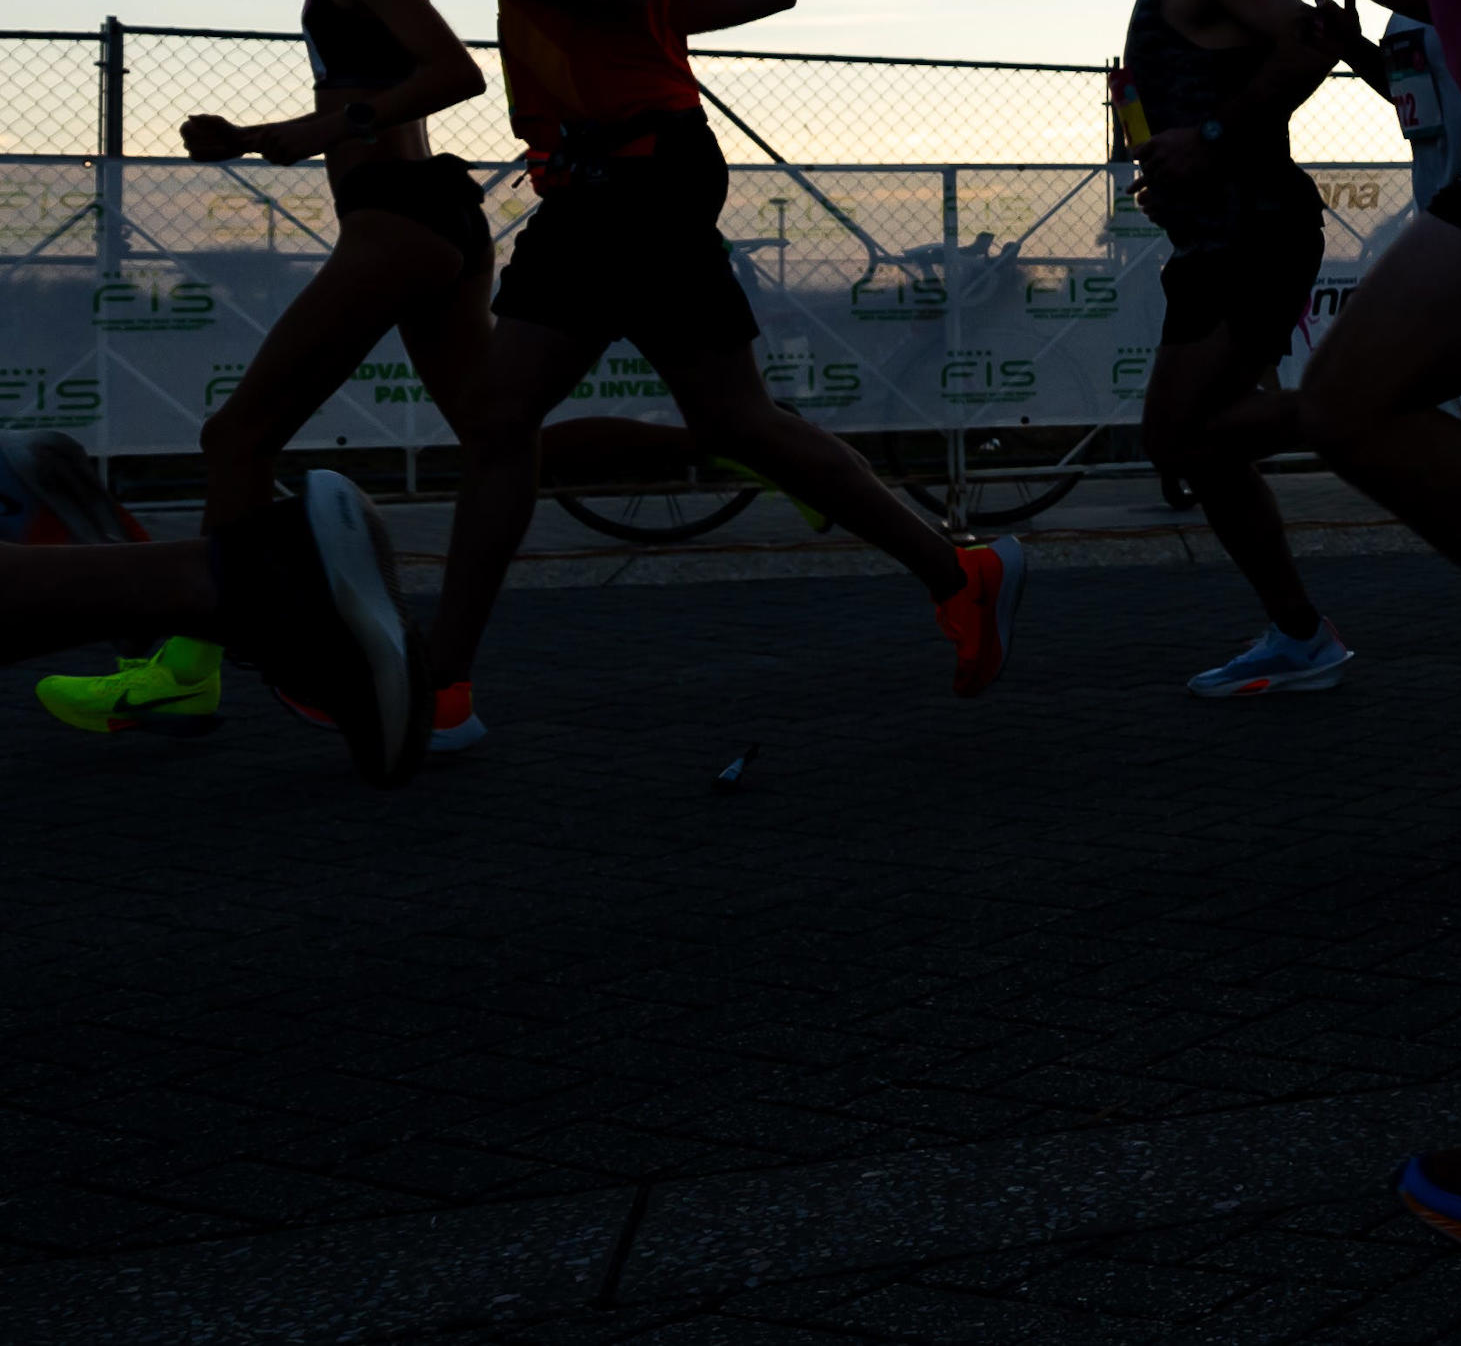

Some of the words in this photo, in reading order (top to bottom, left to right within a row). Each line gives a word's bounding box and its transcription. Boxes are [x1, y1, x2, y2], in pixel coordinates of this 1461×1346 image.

[92, 283, 215, 314] FIS
[851, 278, 948, 306] FIS
[1025, 277, 1118, 304] FIS
[763, 363, 861, 391] FIS
[941, 359, 1035, 388] FIS
